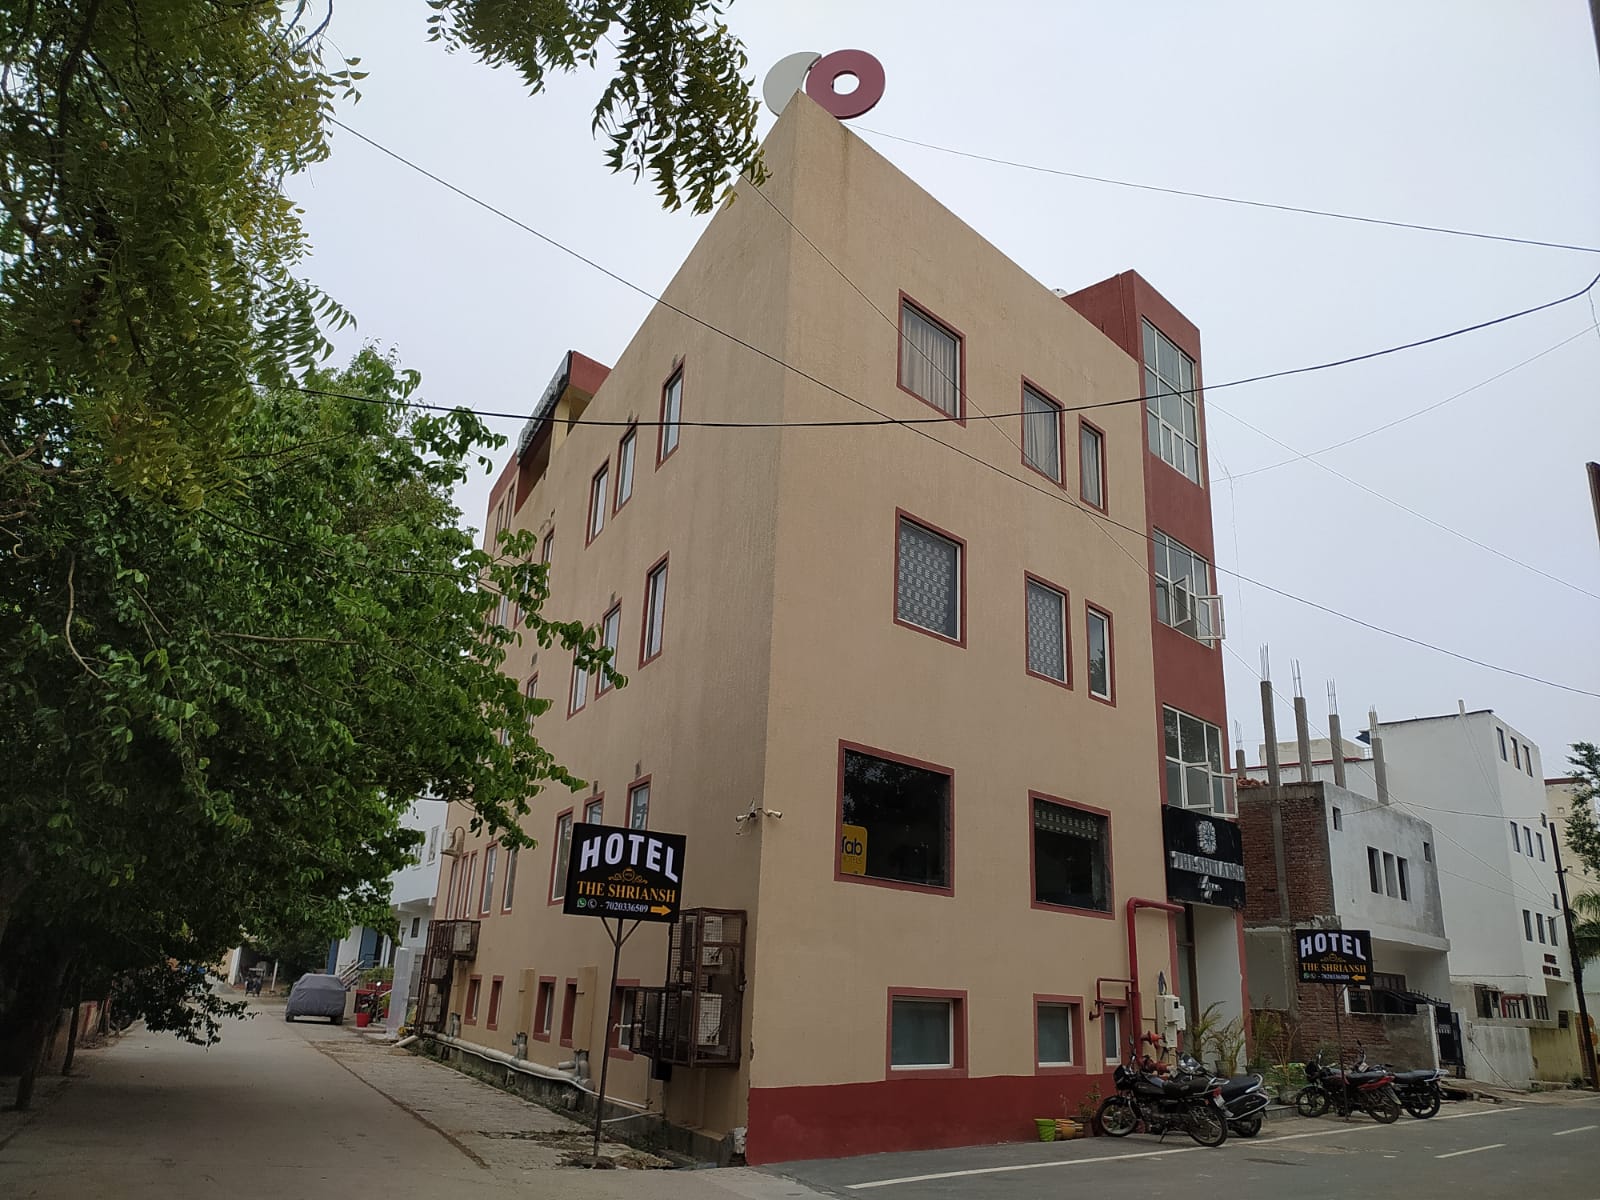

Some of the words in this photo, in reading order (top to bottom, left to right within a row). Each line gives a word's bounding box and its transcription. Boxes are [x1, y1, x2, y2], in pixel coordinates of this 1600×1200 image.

[841, 835, 863, 856] fab
[579, 832, 679, 883] HOTEL
[577, 880, 605, 897] THE
[608, 883, 676, 903] SHRIANSH
[605, 901, 649, 913] 7020336509
[1300, 932, 1367, 961] HOTEL
[1302, 962, 1320, 972] THE
[1321, 963, 1367, 974] SHRIANSH
